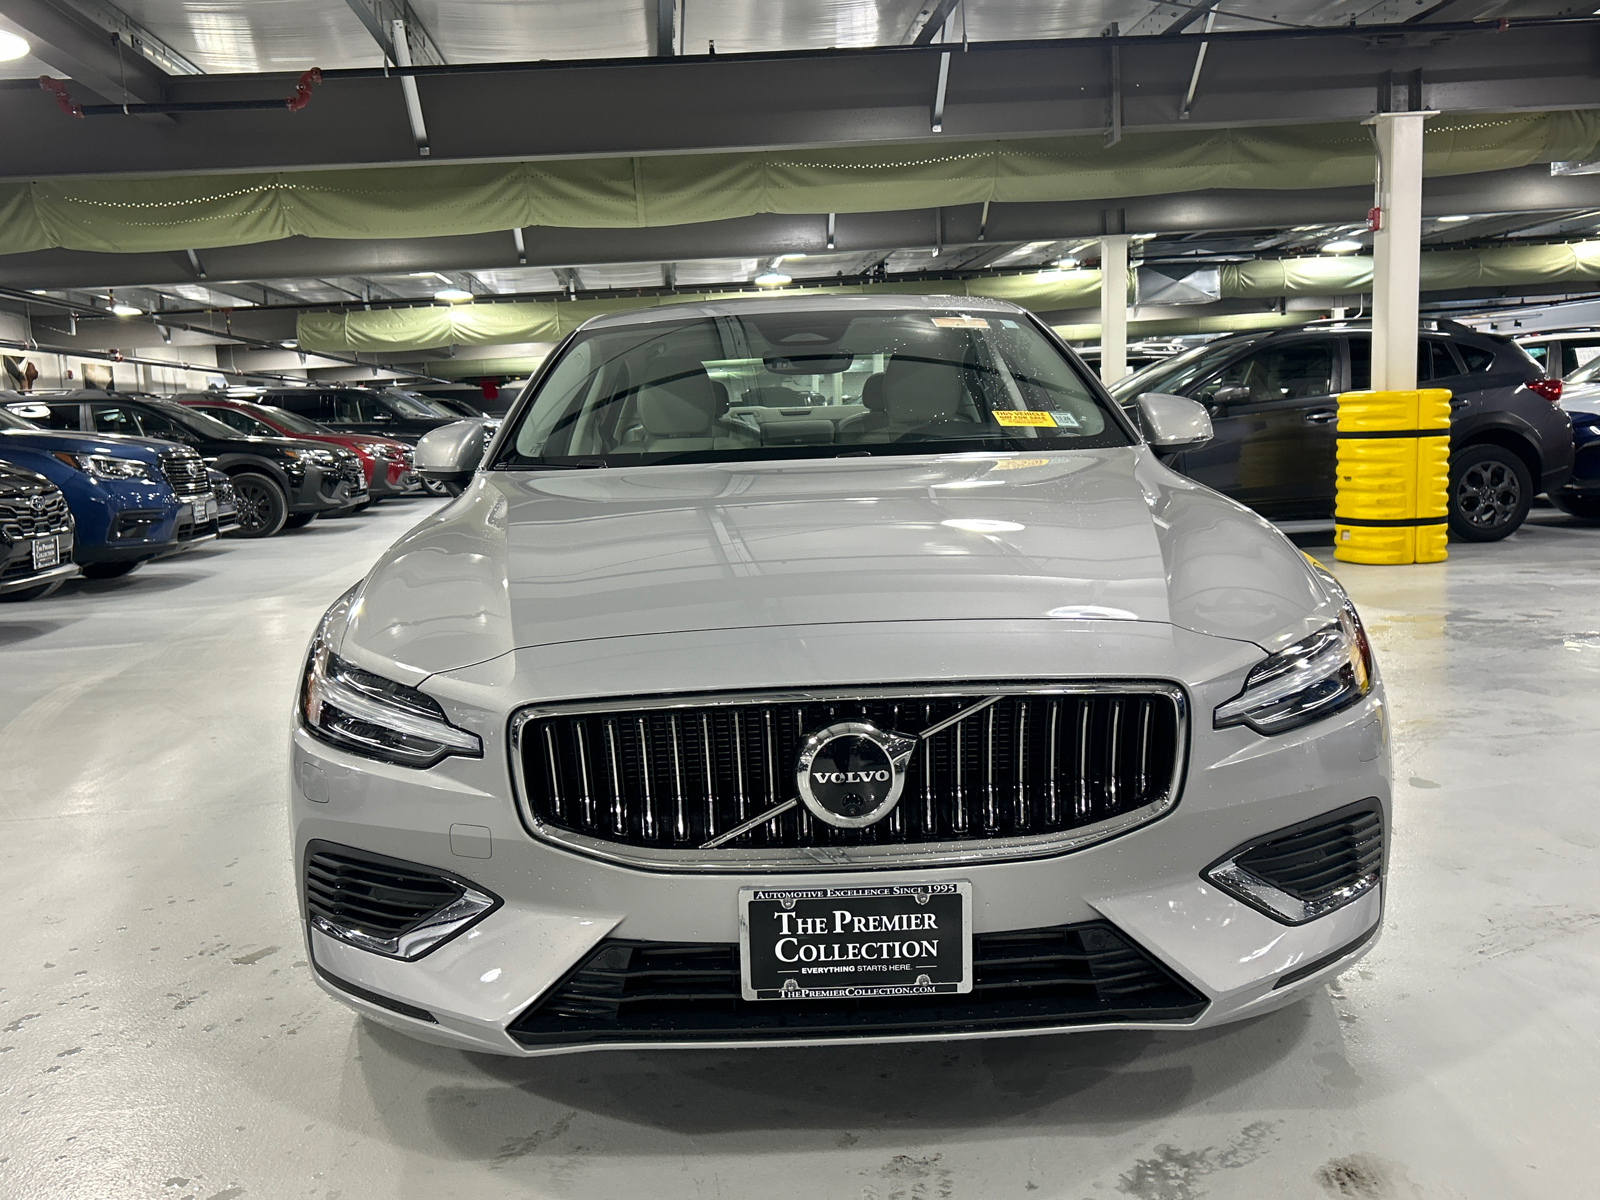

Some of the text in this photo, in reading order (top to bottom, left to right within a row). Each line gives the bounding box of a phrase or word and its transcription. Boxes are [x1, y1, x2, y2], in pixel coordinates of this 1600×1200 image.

[812, 770, 890, 784] VOLVO
[755, 884, 955, 899] AUTOMOTIVE EXCELLENCE SINCE 1995
[774, 910, 938, 935] THE PREMIER
[774, 937, 938, 963] COLLECTION
[802, 966, 855, 974] EVERYTHING
[778, 986, 936, 998] THEPREMIERCOLLECTION.COM
